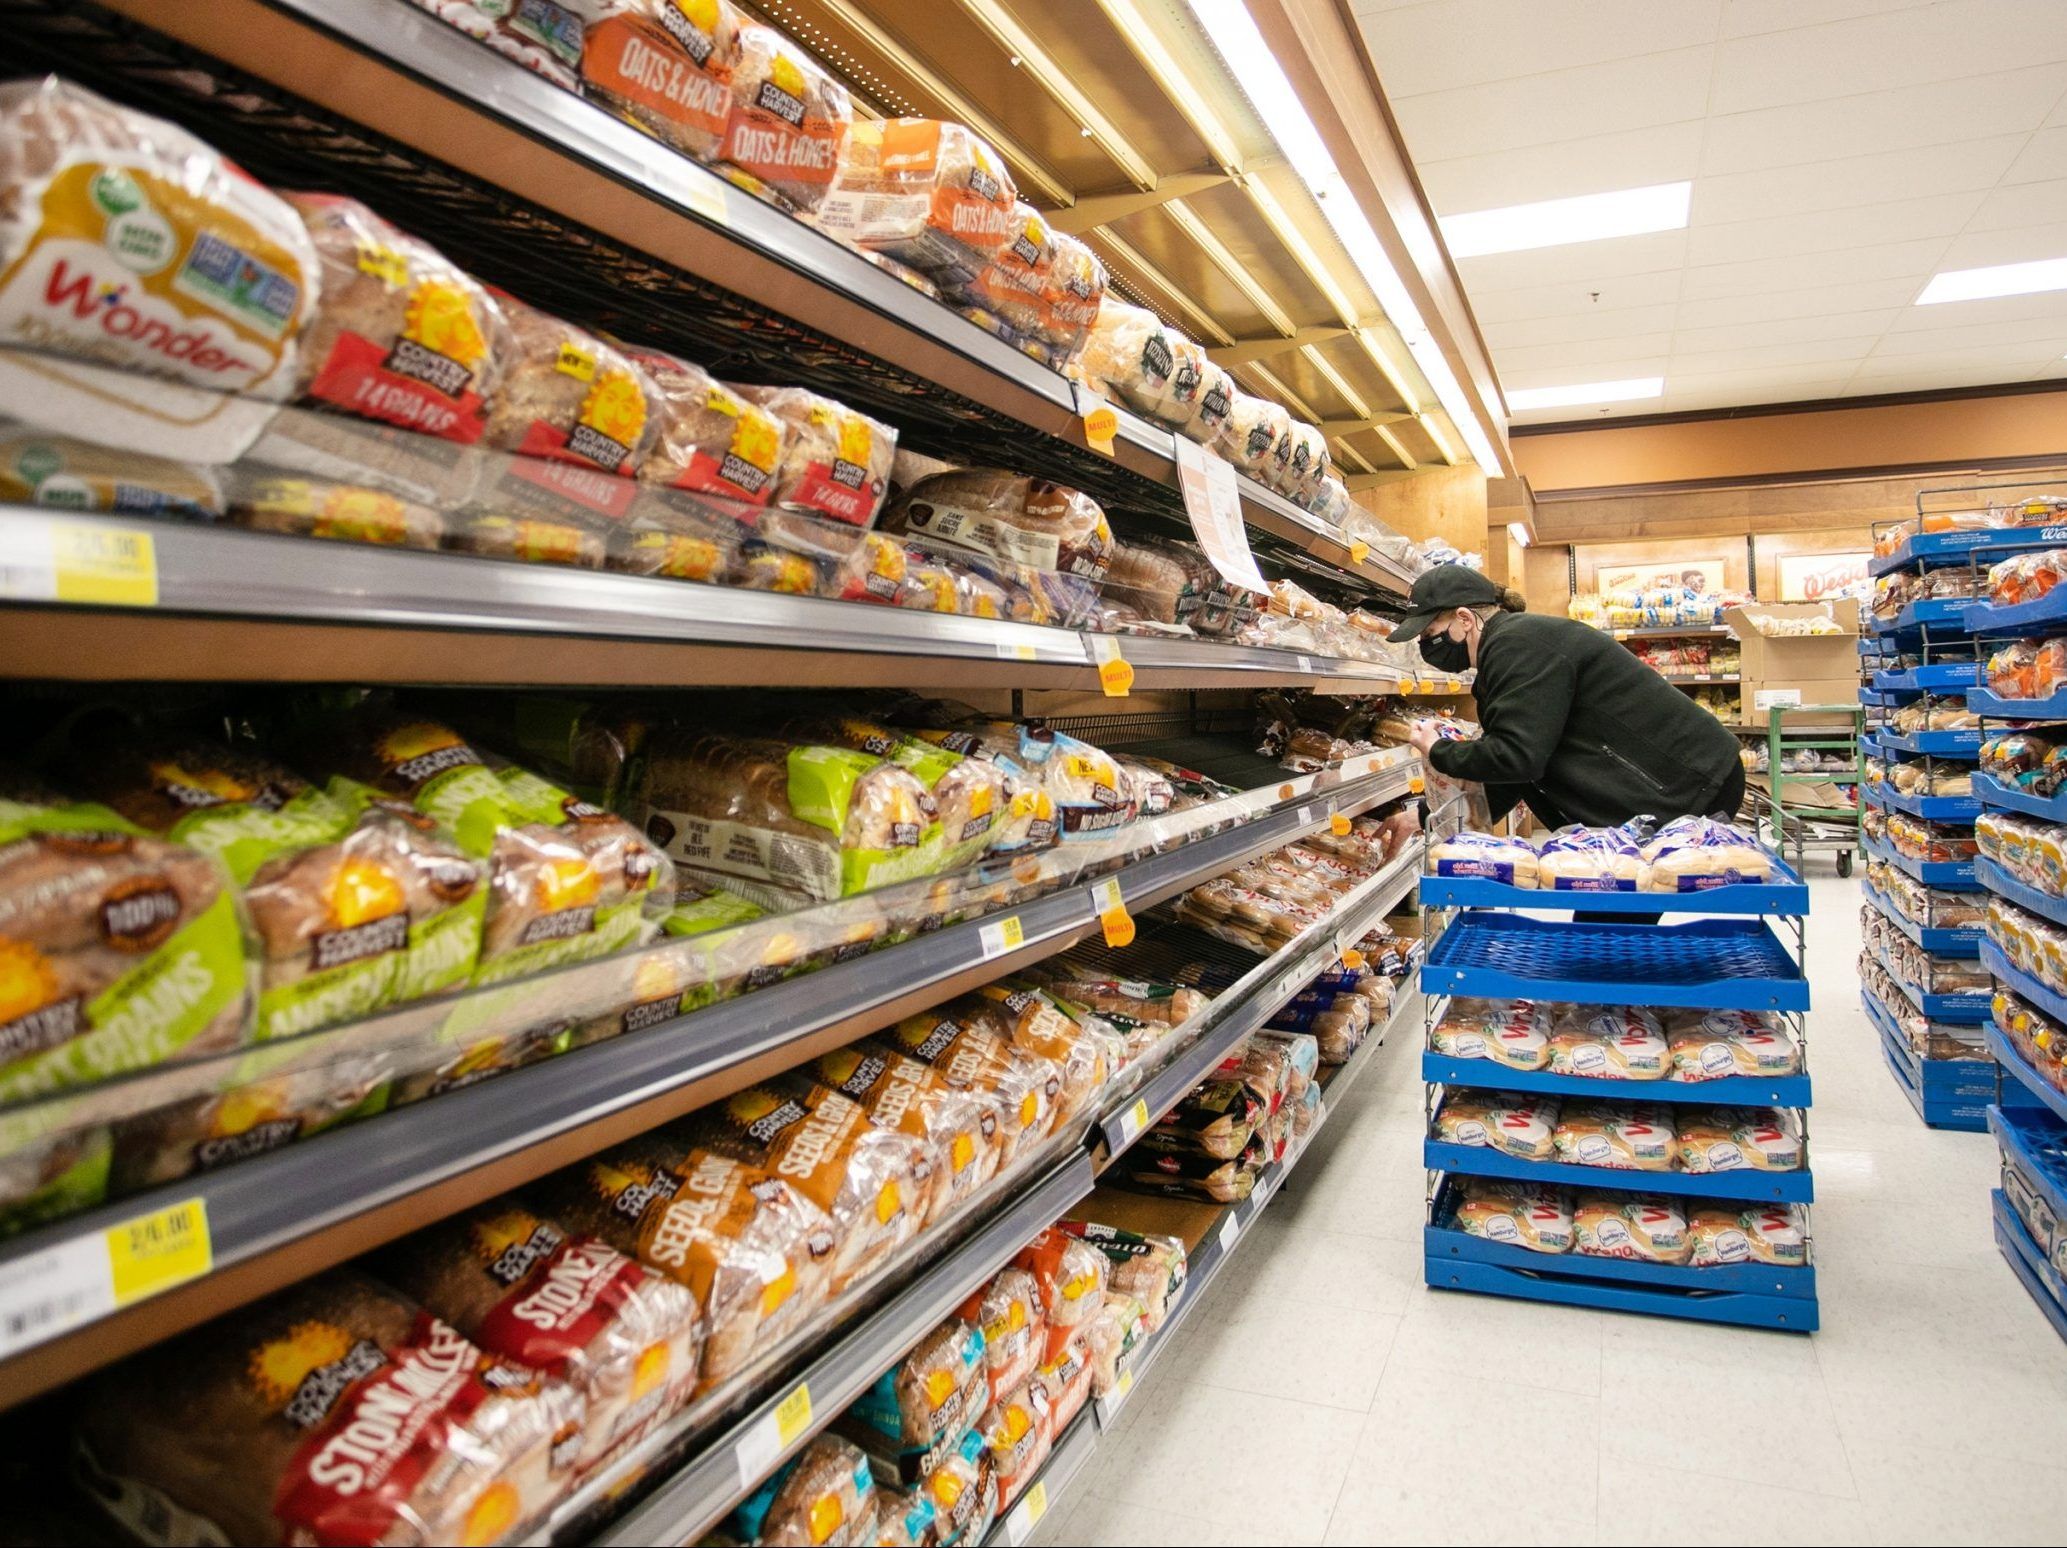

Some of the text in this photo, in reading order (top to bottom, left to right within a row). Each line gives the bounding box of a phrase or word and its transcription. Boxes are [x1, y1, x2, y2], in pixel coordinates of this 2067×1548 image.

[618, 37, 733, 119] OATS & HONEY
[759, 95, 801, 124] HARVEST
[762, 83, 805, 115] COUNTRY
[734, 125, 839, 170] OATS & HONEY
[952, 203, 979, 233] OATS
[43, 257, 257, 373] Wonder
[1087, 417, 1117, 433] MULTI
[569, 436, 620, 470] HARVEST
[573, 425, 631, 461] COUNTRY
[562, 464, 618, 507] GRAINS
[720, 466, 760, 492] HARVEST
[724, 453, 769, 484] COUNTRY
[835, 460, 868, 480] CUNTRY
[1105, 669, 1133, 685] MULTI
[916, 1019, 952, 1057] COUNTRY
[926, 1026, 961, 1063] HARVEST
[749, 1099, 798, 1138] COUNTRY
